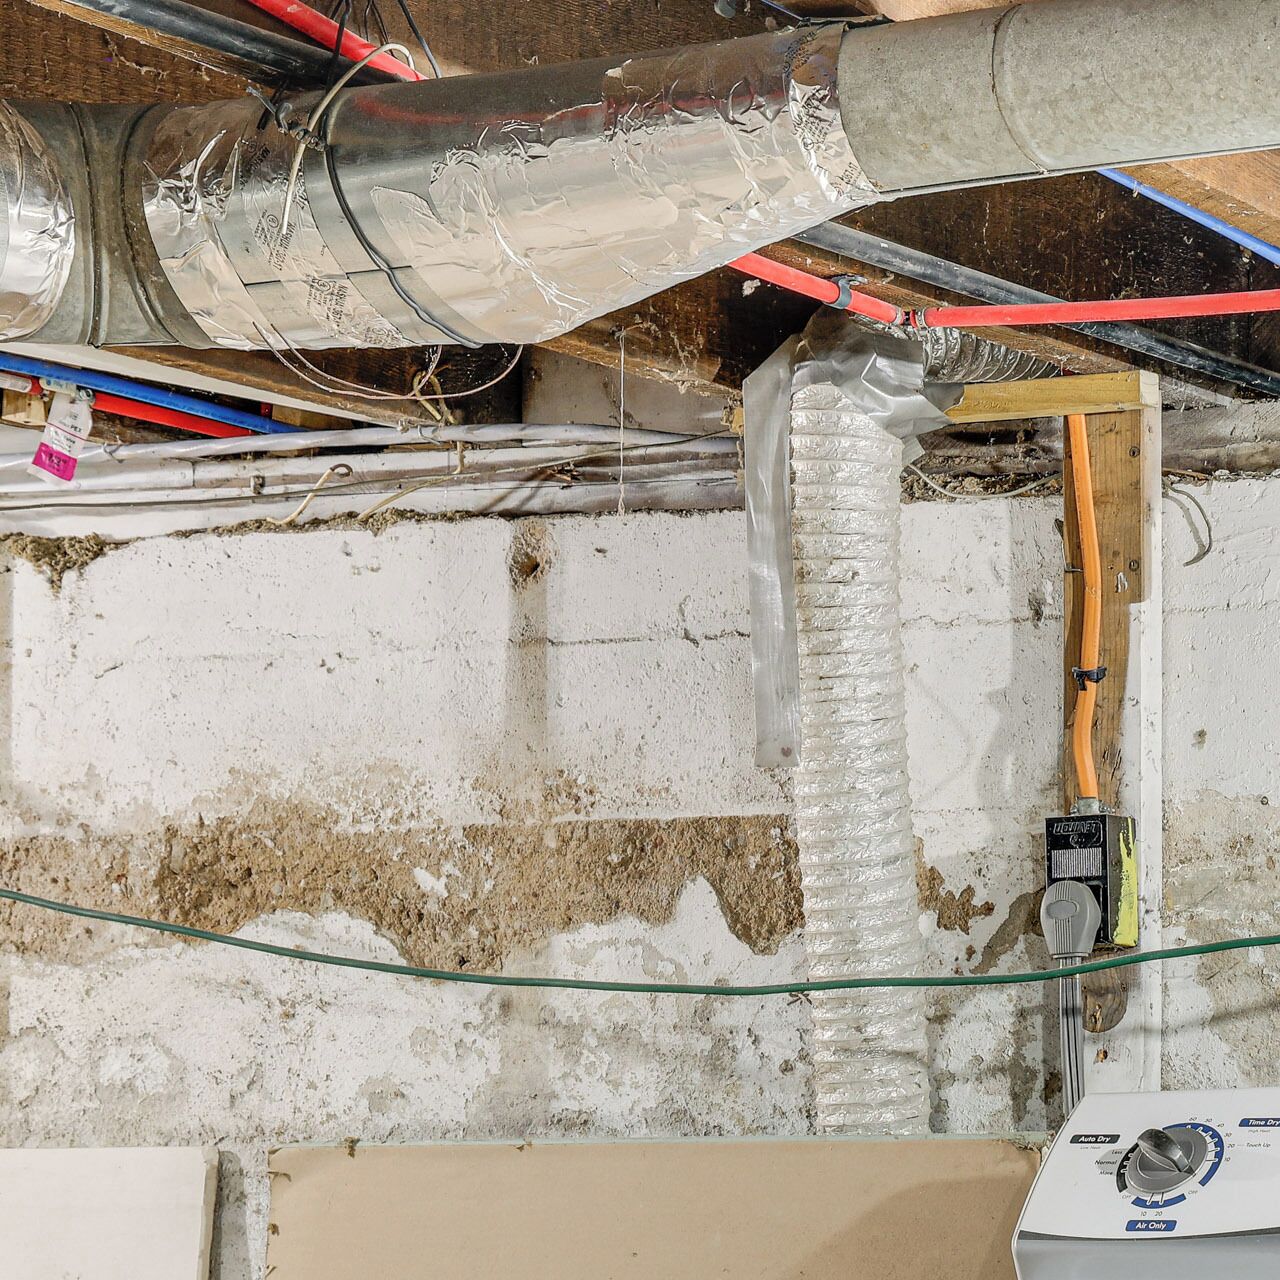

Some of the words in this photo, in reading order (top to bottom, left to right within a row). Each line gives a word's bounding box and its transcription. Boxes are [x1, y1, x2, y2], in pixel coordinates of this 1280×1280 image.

[1266, 1119, 1280, 1127] Dry
[1135, 1221, 1148, 1229] Air
[1148, 1221, 1167, 1230] Only
